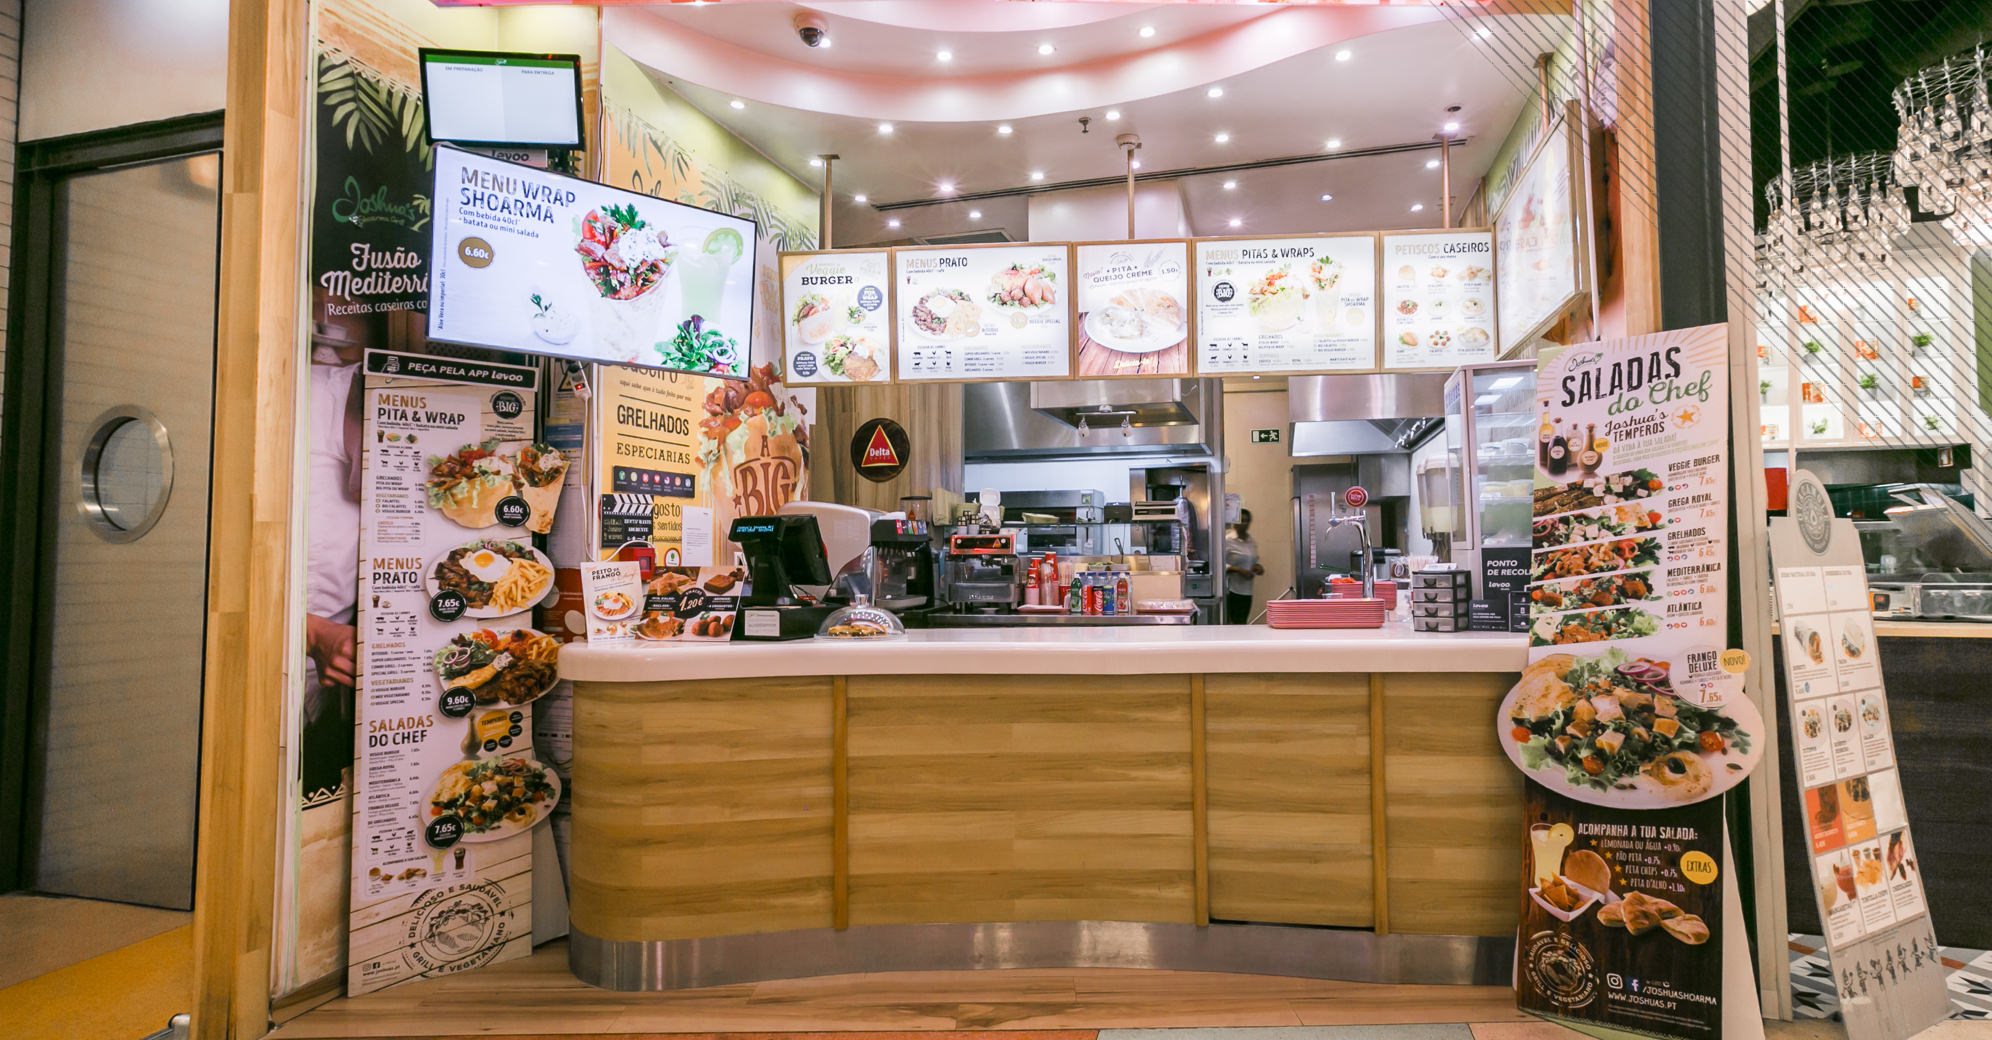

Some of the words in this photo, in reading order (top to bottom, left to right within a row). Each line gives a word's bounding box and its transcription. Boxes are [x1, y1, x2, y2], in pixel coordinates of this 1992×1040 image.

[461, 166, 517, 195] MENU
[522, 180, 576, 208] WRAP
[460, 187, 554, 224] SHOARMA
[459, 207, 474, 216] Com
[476, 210, 500, 222] bebida
[464, 217, 488, 228] batata
[500, 224, 516, 234] mini
[516, 228, 539, 238] salada
[1206, 250, 1239, 260] MENUS
[1242, 248, 1268, 260] PITAS
[1272, 249, 1278, 258] &
[1280, 247, 1315, 258] WRAPS
[1395, 244, 1440, 255] PETISCOS
[1444, 242, 1490, 254] CASEIROS
[350, 243, 422, 272] Fusão
[906, 258, 938, 270] MENUS
[939, 256, 968, 268] PRATO
[1093, 274, 1124, 283] QUEIJO
[1126, 270, 1153, 278] CREME
[1112, 266, 1132, 274] PITA
[801, 276, 853, 286] BURGER
[328, 302, 372, 316] Receitas
[375, 298, 414, 312] caseiras
[408, 362, 438, 374] PEÇA
[439, 366, 465, 376] PELA
[468, 369, 489, 378] APP
[1562, 346, 1681, 408] SALADAS
[1608, 392, 1644, 416] do
[1648, 370, 1712, 404] Chef
[378, 393, 428, 409] MENUS
[499, 400, 516, 413] BIG
[378, 408, 408, 422] PITA
[411, 410, 422, 422] &
[425, 412, 465, 426] WRAP
[617, 404, 689, 436] GRELHADOS
[1604, 408, 1668, 436] Joshua's
[1614, 422, 1665, 442] TEMPEROS
[616, 442, 690, 464] ESPECIARIAS
[760, 435, 770, 458] A
[870, 448, 890, 456] Delta
[1668, 460, 1690, 472] VEGGIE
[1694, 454, 1720, 467] BURGER
[739, 462, 791, 515] BIG
[1668, 496, 1690, 508] GREGA
[1692, 493, 1712, 504] ROYAL
[503, 505, 524, 514] 6.60€
[654, 502, 680, 520] gosto
[1668, 527, 1706, 540] GRELHADOS
[372, 558, 422, 570] MENUS
[1667, 562, 1721, 578] MEDITERRÂNICA
[372, 572, 418, 584] PRATO
[592, 568, 612, 576] PEITO
[592, 572, 621, 581] FRANGO
[438, 599, 460, 608] 7.65€
[680, 596, 704, 612] 1.20€
[1667, 601, 1702, 613] ATLÂNTICA
[1688, 650, 1717, 664] FRANGO
[1724, 655, 1746, 666] NOVO!
[1688, 660, 1718, 674] DELUXE
[447, 696, 468, 705] 9.60€
[1700, 690, 1722, 703] 7.65€
[369, 715, 434, 734] SALADAS
[369, 734, 388, 748] DO
[392, 730, 428, 745] CHEF
[434, 822, 456, 834] 7.65€
[1578, 822, 1628, 836] ACOMPANHA
[1631, 826, 1637, 838] A
[1640, 826, 1656, 838] TUA
[1659, 826, 1698, 840] SALADA:
[1635, 841, 1644, 850] OU
[1646, 840, 1662, 850] ÁGUA
[1616, 851, 1626, 861] PÃO
[1628, 853, 1642, 862] PITA
[1625, 866, 1639, 876] PITA
[1640, 866, 1658, 876] CHIPS
[1686, 860, 1712, 873] EXTRAS
[1630, 878, 1645, 888] PITA
[408, 890, 444, 939] DELICIOSO
[459, 882, 502, 908] SAUDÁVEL
[412, 952, 434, 971] GRILL
[449, 922, 506, 972] VEGETARIANO
[1608, 991, 1677, 1010] WWW.JOSHUAS.PT
[1642, 986, 1717, 1006] /JOSHUASHOARMA
